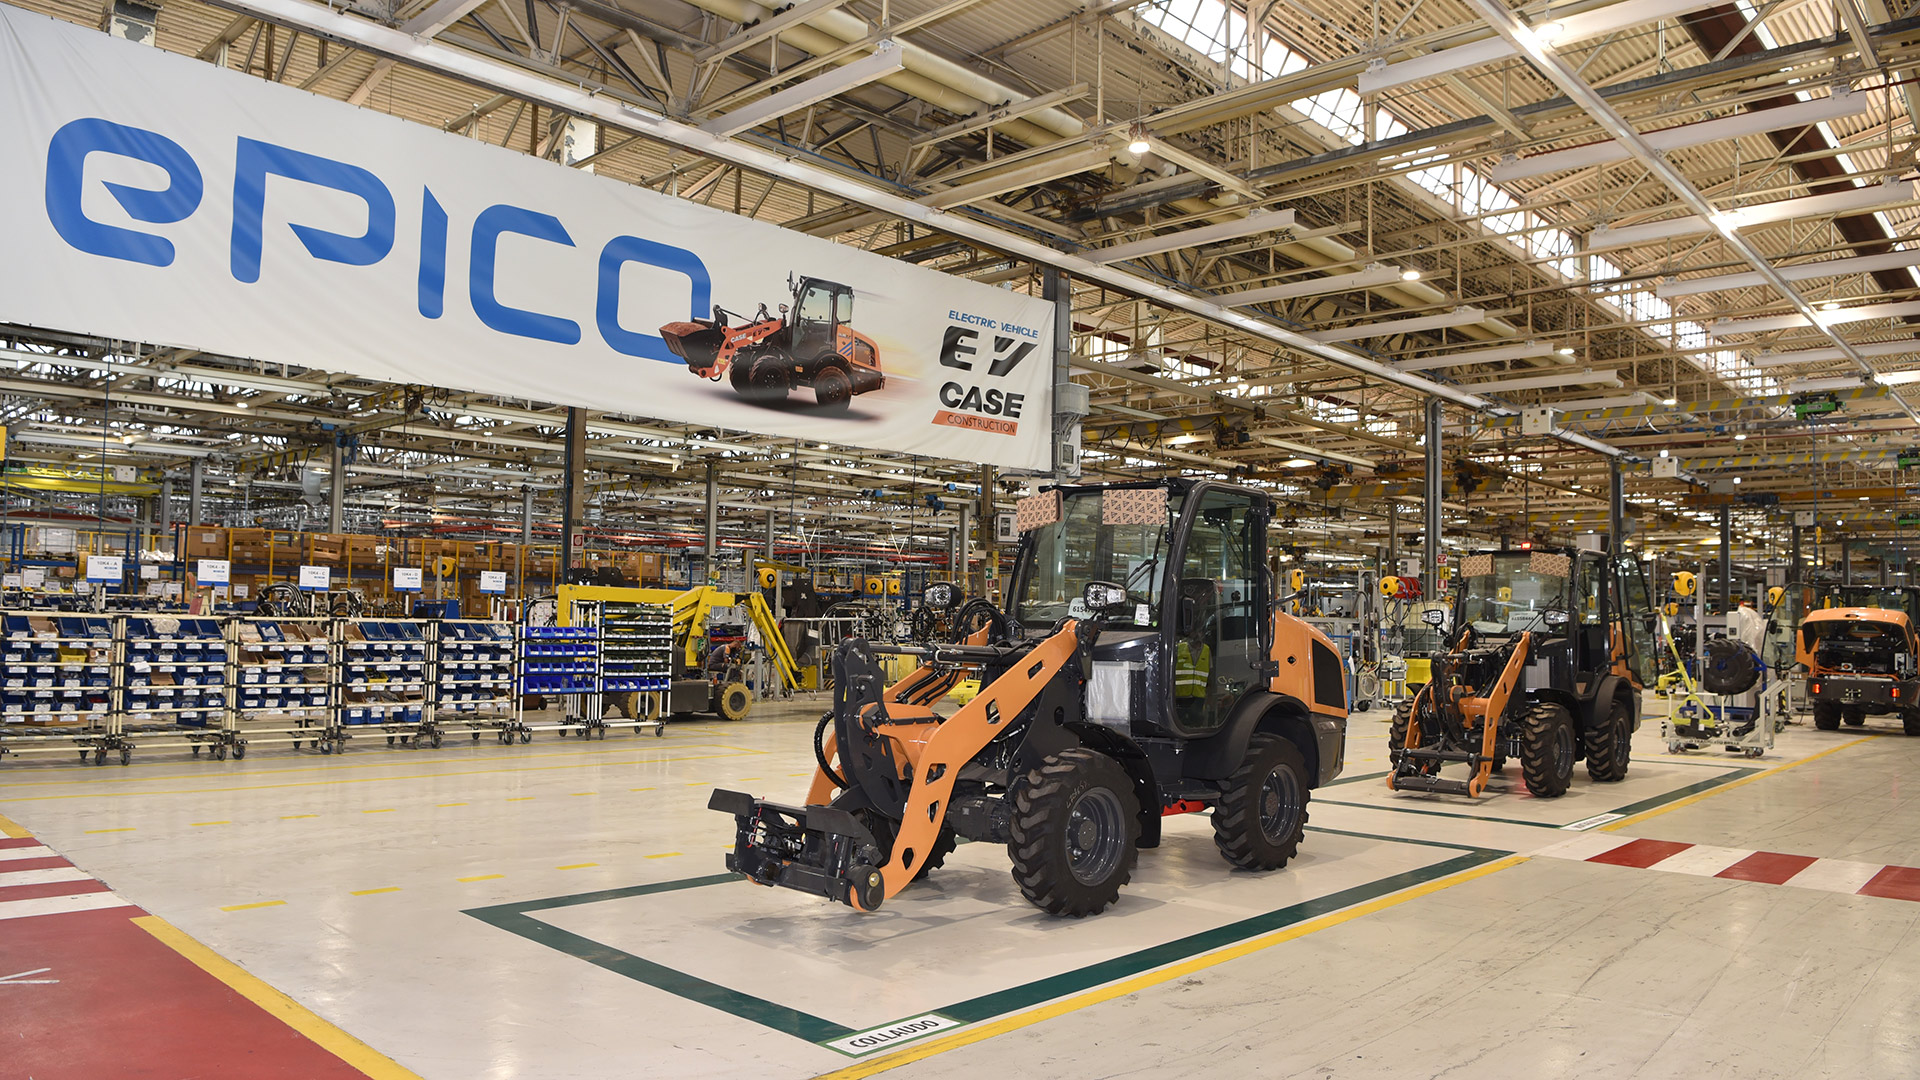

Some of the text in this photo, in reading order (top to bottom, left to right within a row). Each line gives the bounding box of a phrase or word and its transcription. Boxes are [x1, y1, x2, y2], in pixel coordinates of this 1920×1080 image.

[948, 309, 1039, 339] ELECTRIC VEHICLE
[939, 381, 1025, 419] CASE
[947, 414, 1016, 433] CONSTRUCTION
[849, 1020, 940, 1048] COLLAUDO
